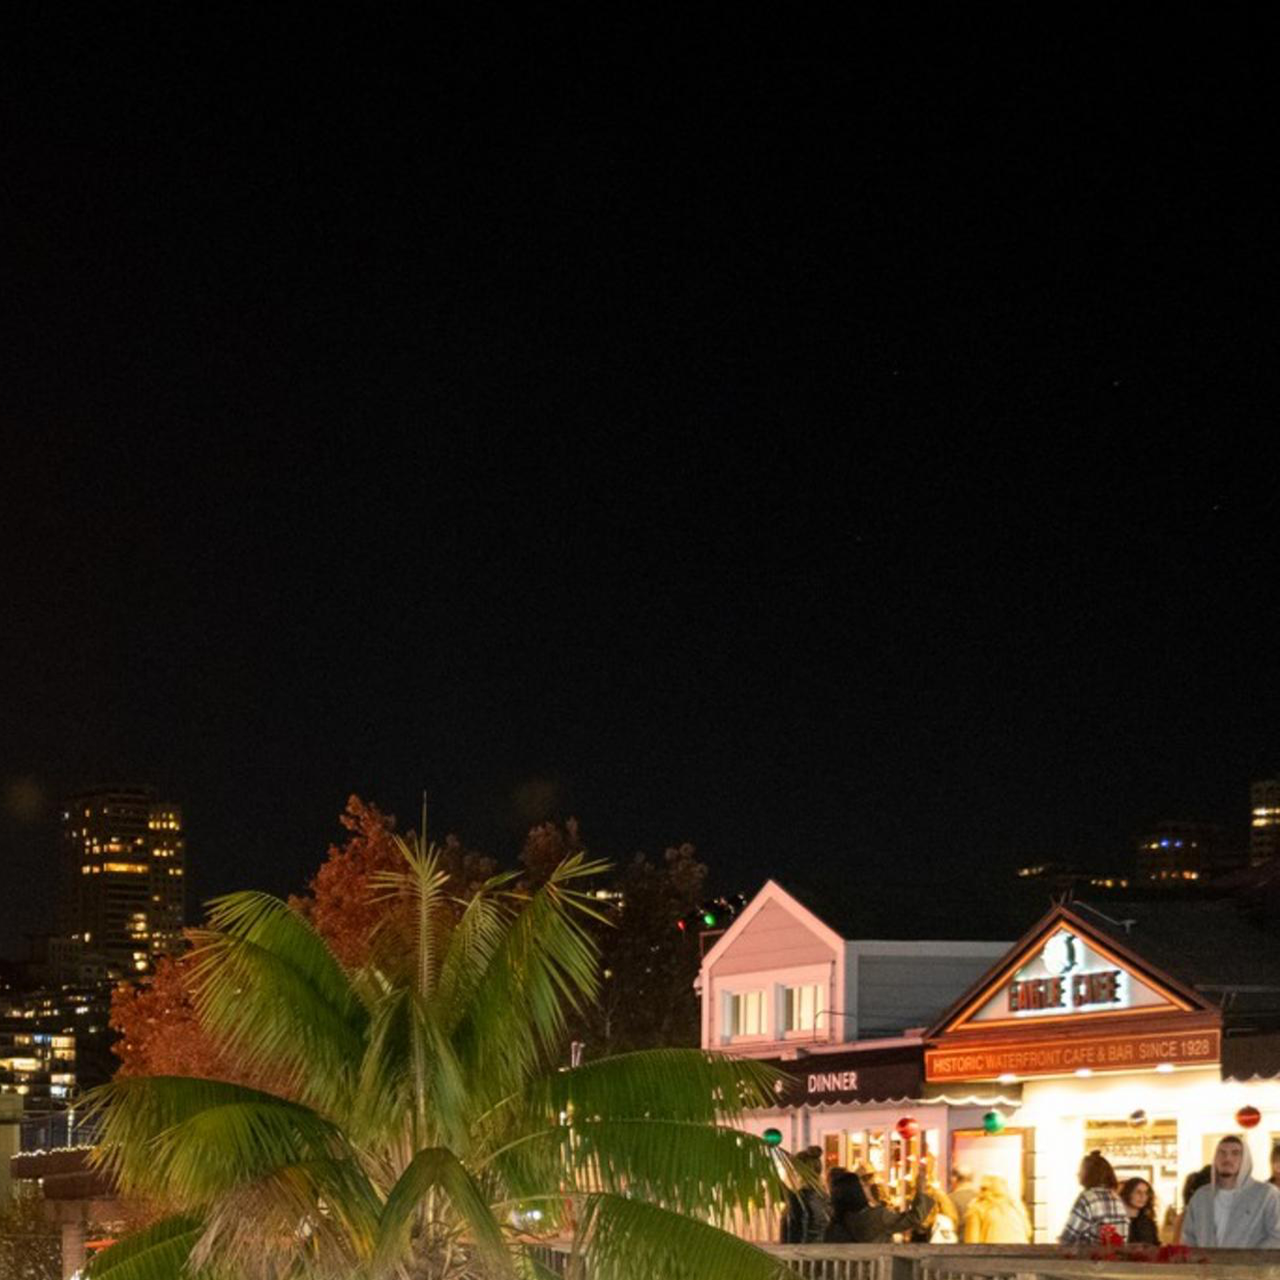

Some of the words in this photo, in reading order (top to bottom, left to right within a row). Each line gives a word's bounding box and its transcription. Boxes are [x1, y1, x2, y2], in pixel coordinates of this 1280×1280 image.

[1008, 976, 1066, 1011] EAGLE
[932, 1055, 985, 1073] HISTORIC
[986, 1049, 1062, 1071] WATERFRONT
[1063, 1047, 1095, 1065] CAFE
[1097, 1047, 1106, 1061] &
[1108, 1044, 1134, 1061] BAR
[1139, 1041, 1178, 1060] SINCE
[1180, 1038, 1211, 1057] 1928
[807, 1071, 858, 1093] DINNER
